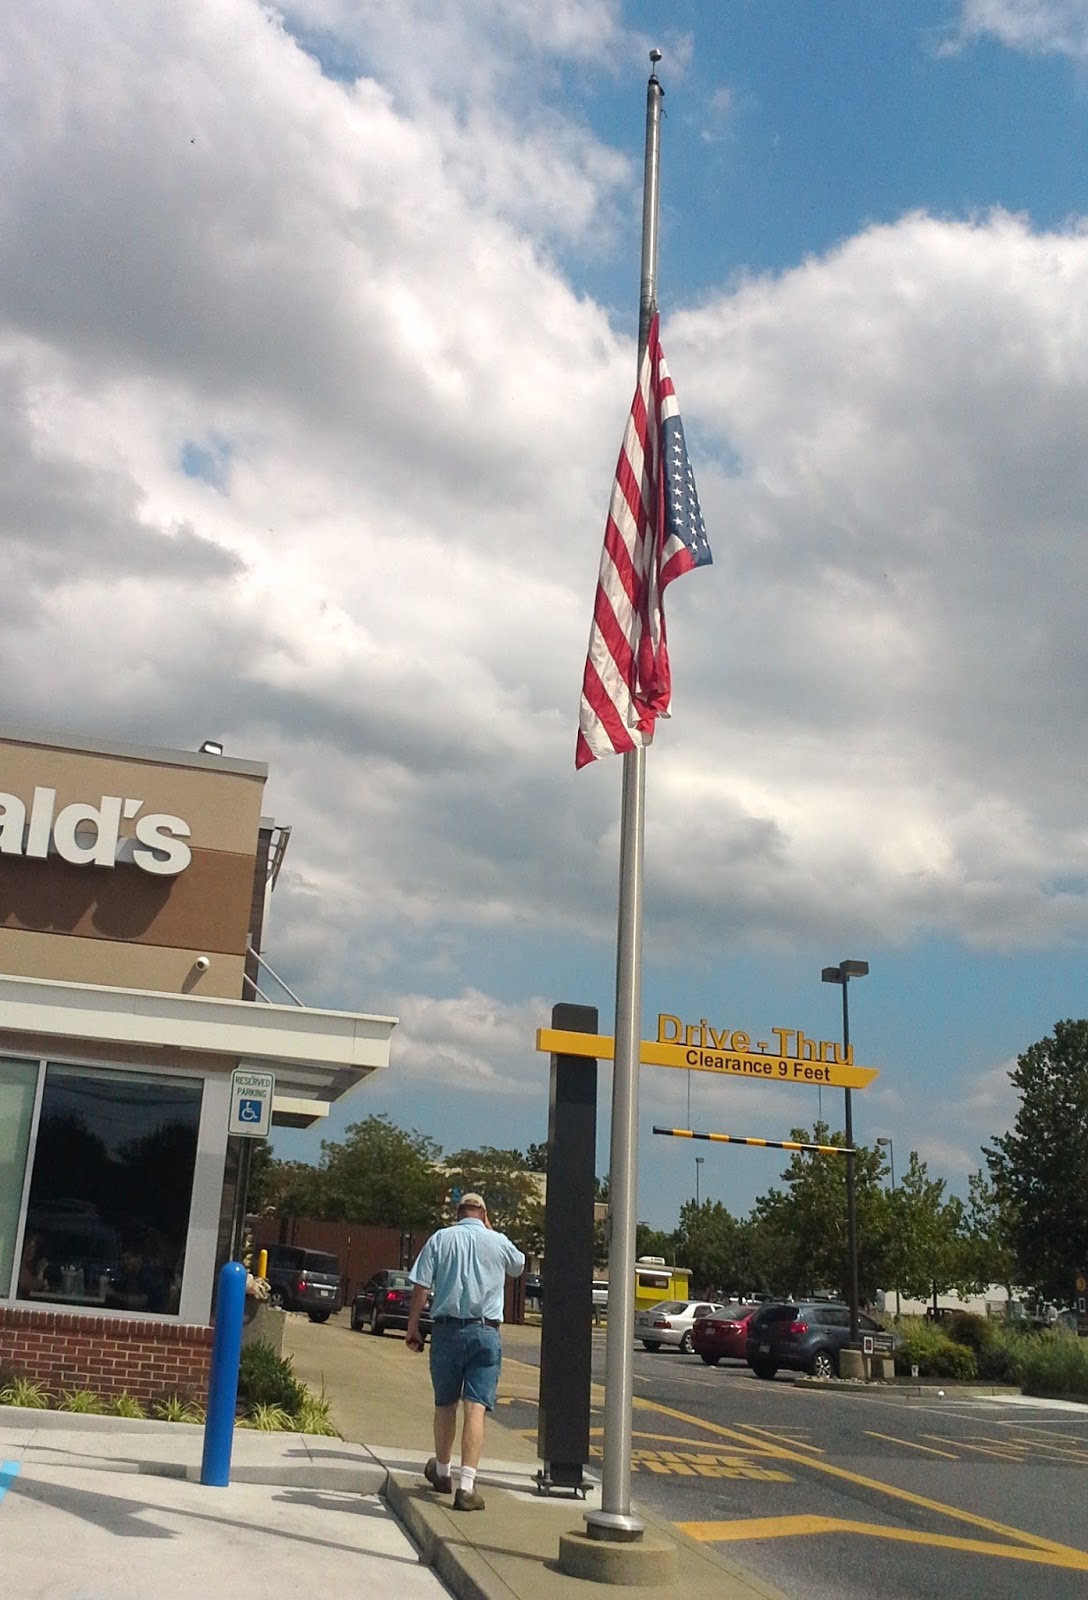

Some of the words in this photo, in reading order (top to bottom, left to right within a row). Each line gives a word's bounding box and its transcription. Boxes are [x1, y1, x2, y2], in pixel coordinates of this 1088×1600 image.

[685, 1049, 773, 1075] Clearance
[778, 1061, 788, 1076] 9
[793, 1062, 831, 1081] Feet
[235, 1076, 270, 1087] RESERVED
[237, 1087, 266, 1097] PARKING
